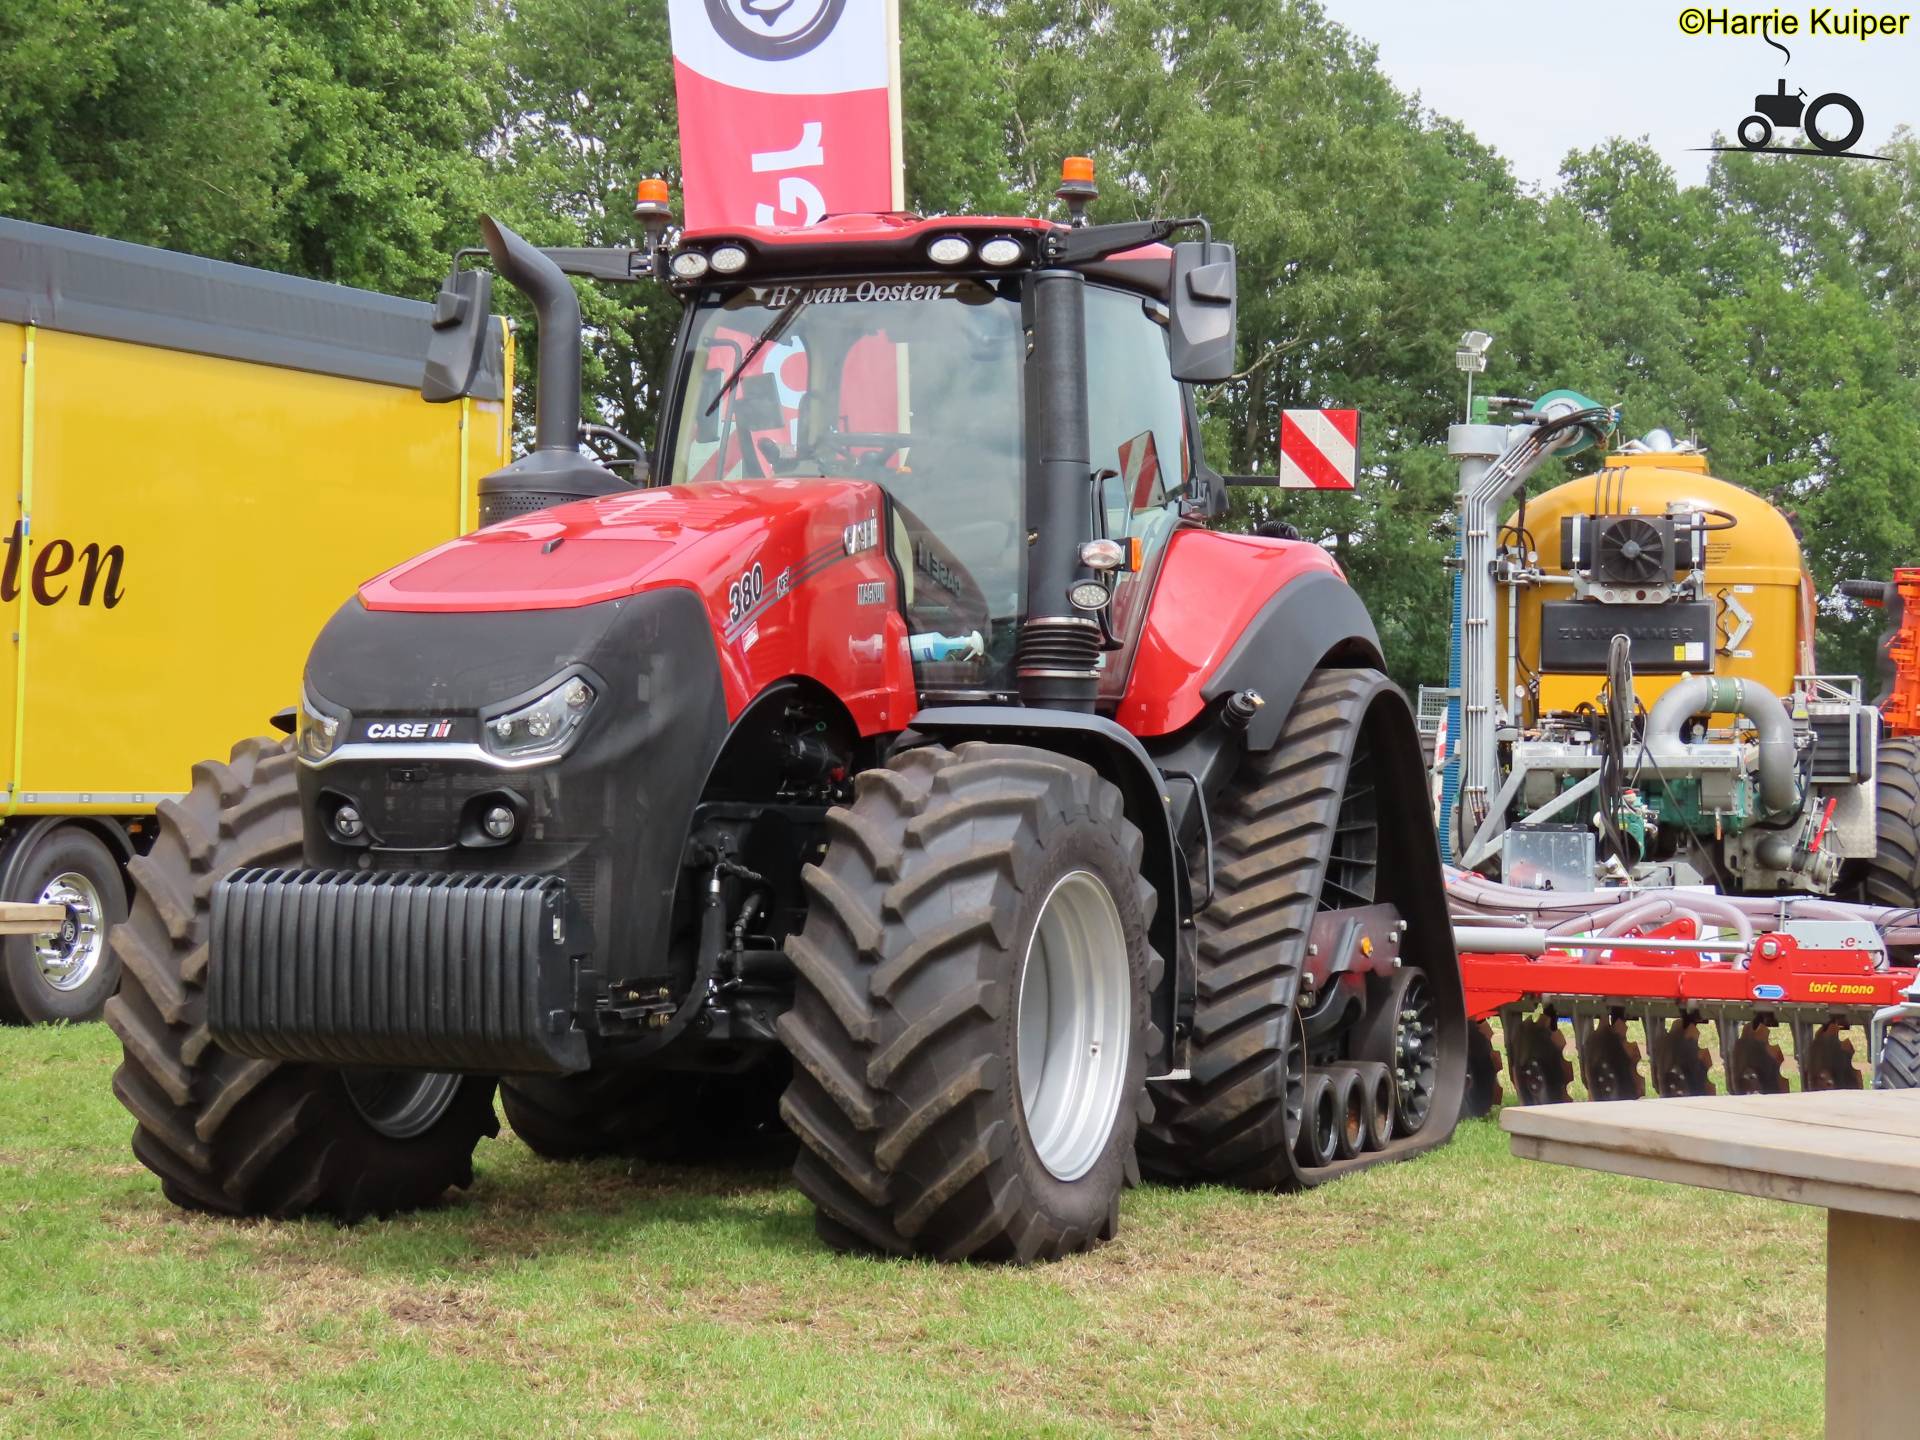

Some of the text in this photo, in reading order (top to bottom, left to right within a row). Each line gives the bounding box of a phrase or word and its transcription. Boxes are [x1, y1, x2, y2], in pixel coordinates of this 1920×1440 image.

[803, 287, 848, 304] van
[856, 280, 941, 301] Oosten
[729, 561, 764, 624] 380
[367, 723, 428, 738] CASE
[1809, 981, 1874, 994] toric mono
